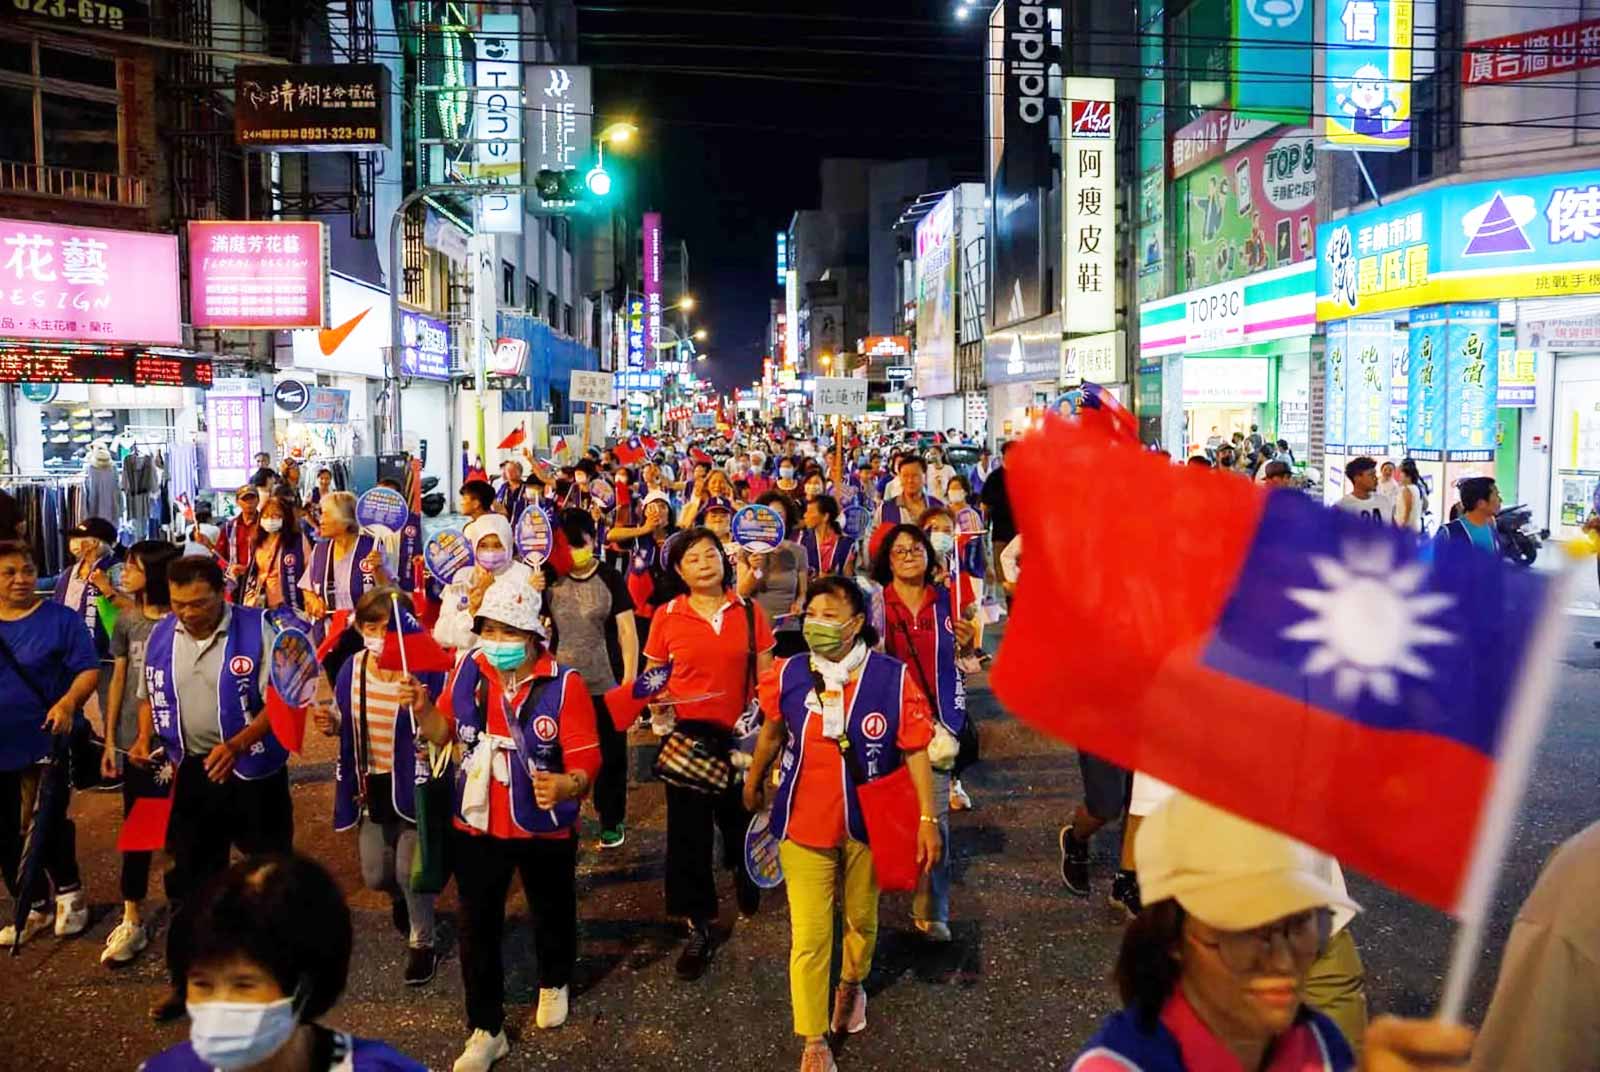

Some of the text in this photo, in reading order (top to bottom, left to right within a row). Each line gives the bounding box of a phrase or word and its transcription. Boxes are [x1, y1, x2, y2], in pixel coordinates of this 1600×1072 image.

[1341, 0, 1379, 42] 信
[1077, 149, 1103, 293] 阿瘦皮鞋
[4, 232, 109, 287] 花藝
[1357, 243, 1429, 297] 最低價
[0, 287, 112, 312] ESIGN
[1190, 290, 1241, 325] TOP3C
[819, 388, 865, 407] 花蓮市
